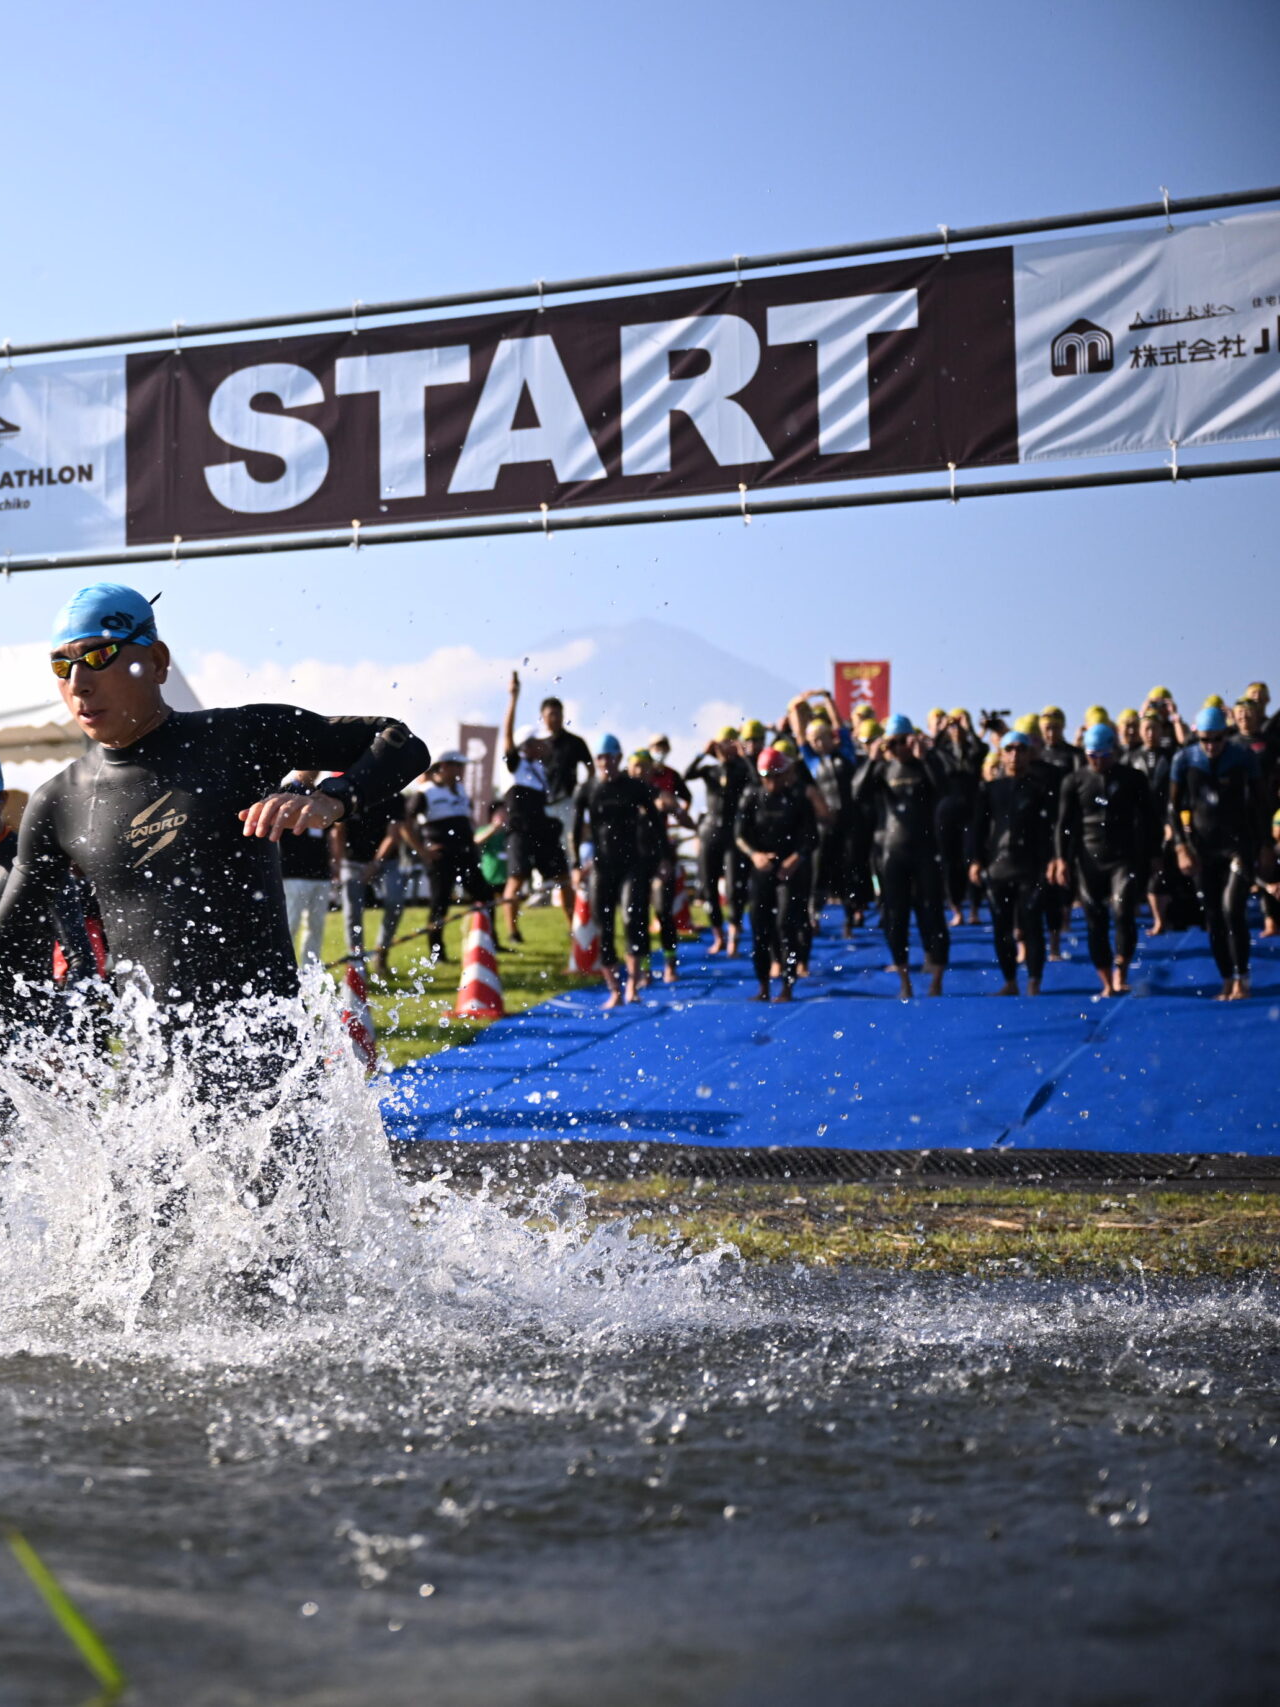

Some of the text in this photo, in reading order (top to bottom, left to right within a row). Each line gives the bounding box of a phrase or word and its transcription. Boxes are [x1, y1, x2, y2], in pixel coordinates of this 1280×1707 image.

[1252, 296, 1280, 308] 住宅
[1129, 334, 1247, 369] 株式会社
[203, 287, 919, 514] START
